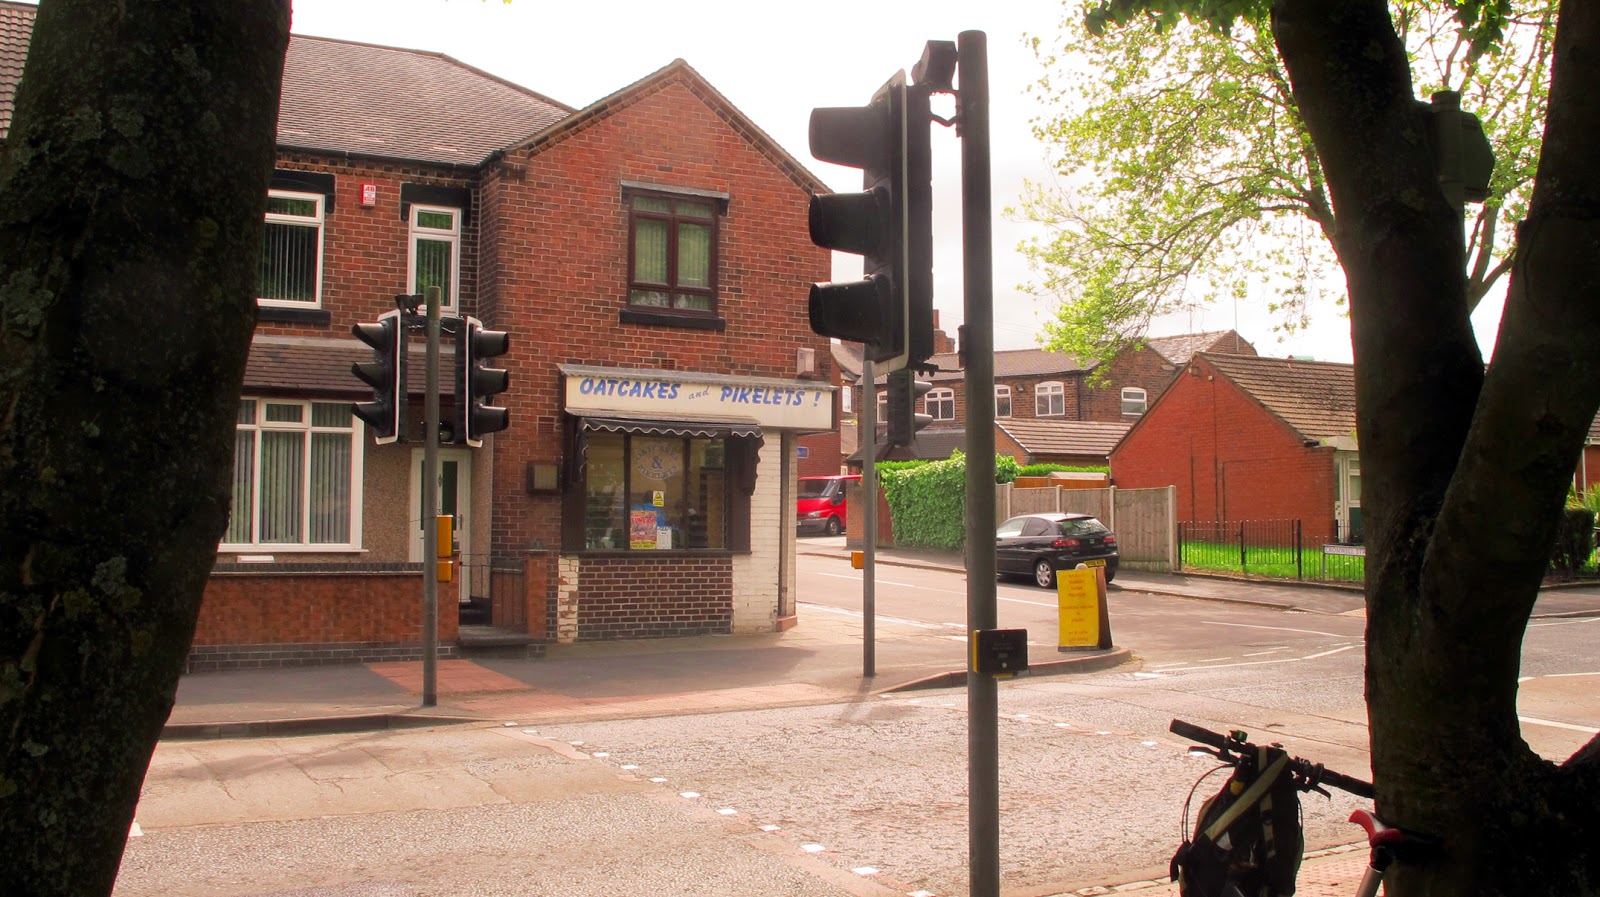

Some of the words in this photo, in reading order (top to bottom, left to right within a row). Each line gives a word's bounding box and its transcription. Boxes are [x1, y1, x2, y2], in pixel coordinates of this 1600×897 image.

[579, 378, 681, 399] OATCAKES
[688, 385, 710, 400] and
[720, 386, 805, 406] PIKELETS
